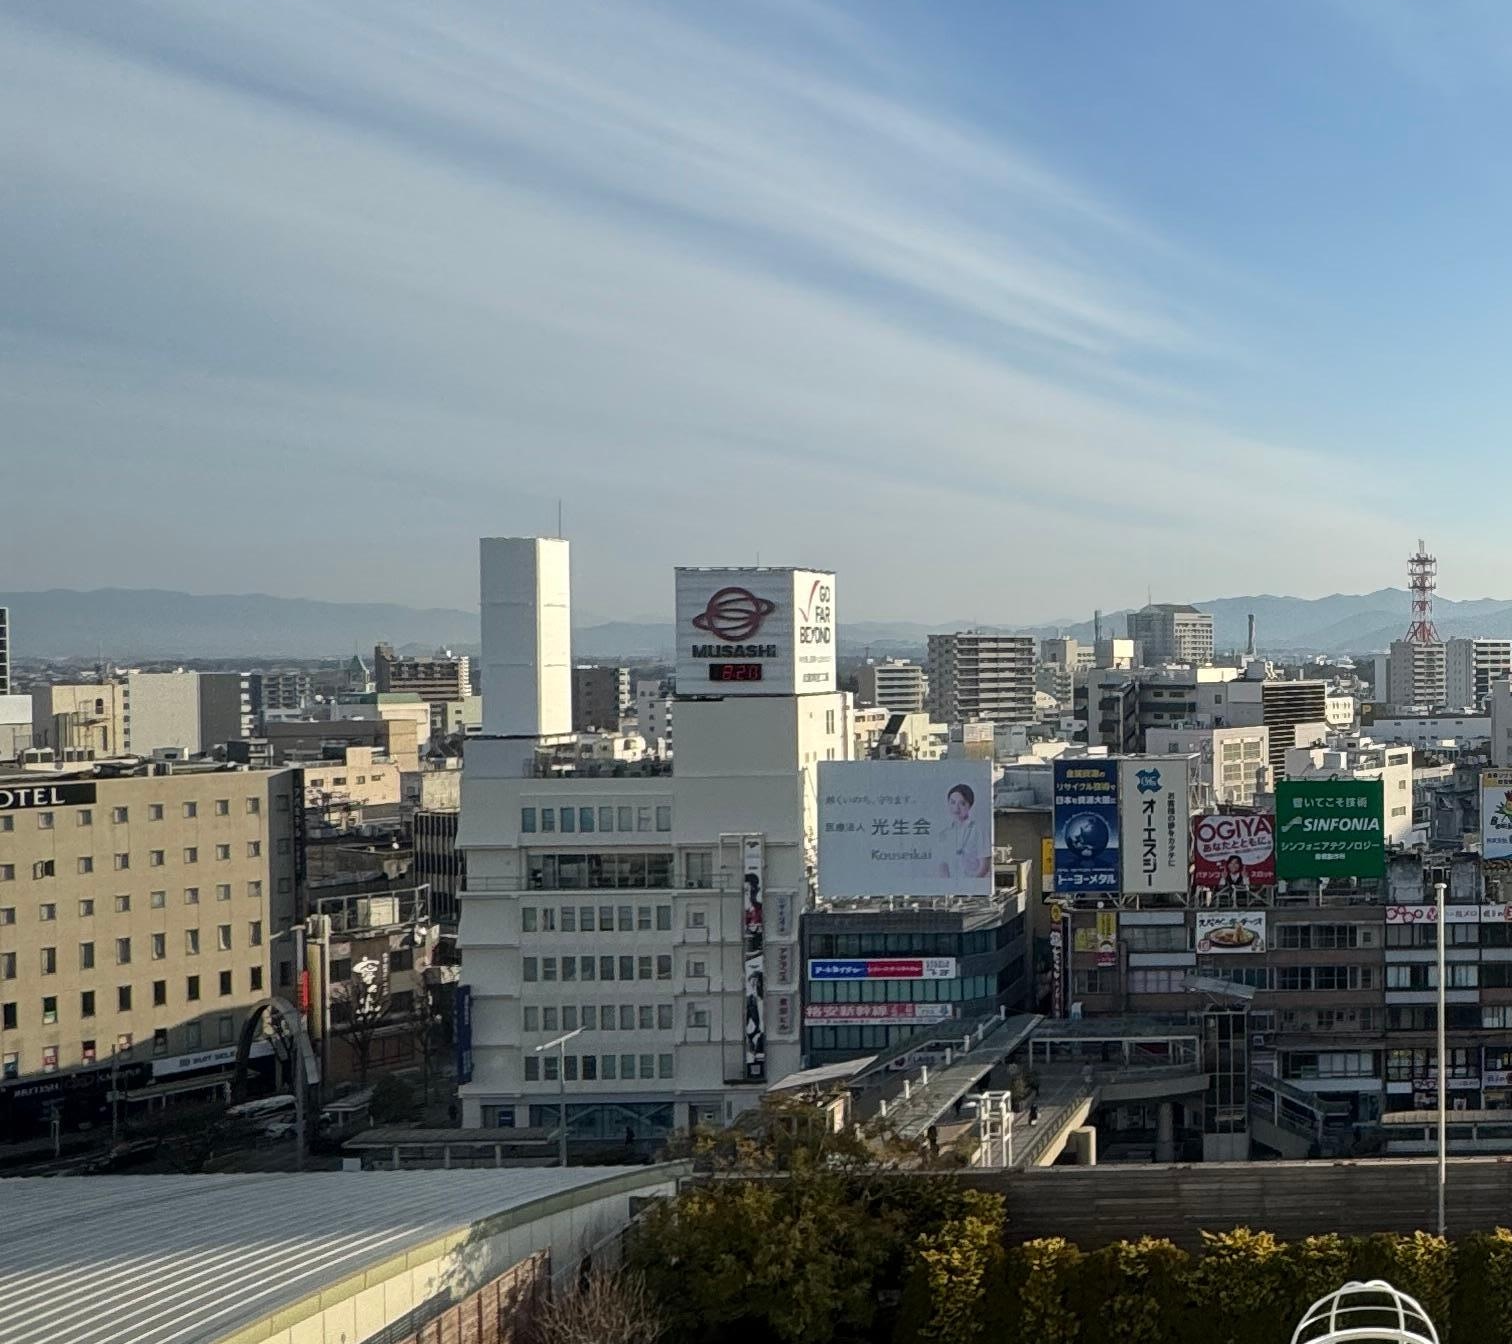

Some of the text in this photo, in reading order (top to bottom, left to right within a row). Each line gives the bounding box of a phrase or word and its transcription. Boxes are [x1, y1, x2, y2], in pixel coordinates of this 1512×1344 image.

[819, 585, 830, 603] GO
[815, 606, 830, 623] FAR
[800, 626, 830, 644] BEYOND
[692, 644, 776, 657] MUSASHI
[871, 817, 930, 835] 光生会
[1198, 817, 1272, 842] OGIYA
[1303, 817, 1380, 831] SINFONIA
[1142, 798, 1157, 886] オーエスジー
[1281, 840, 1380, 851] シンフォニアテクノロジー
[1058, 874, 1116, 885] トーヨーメタル
